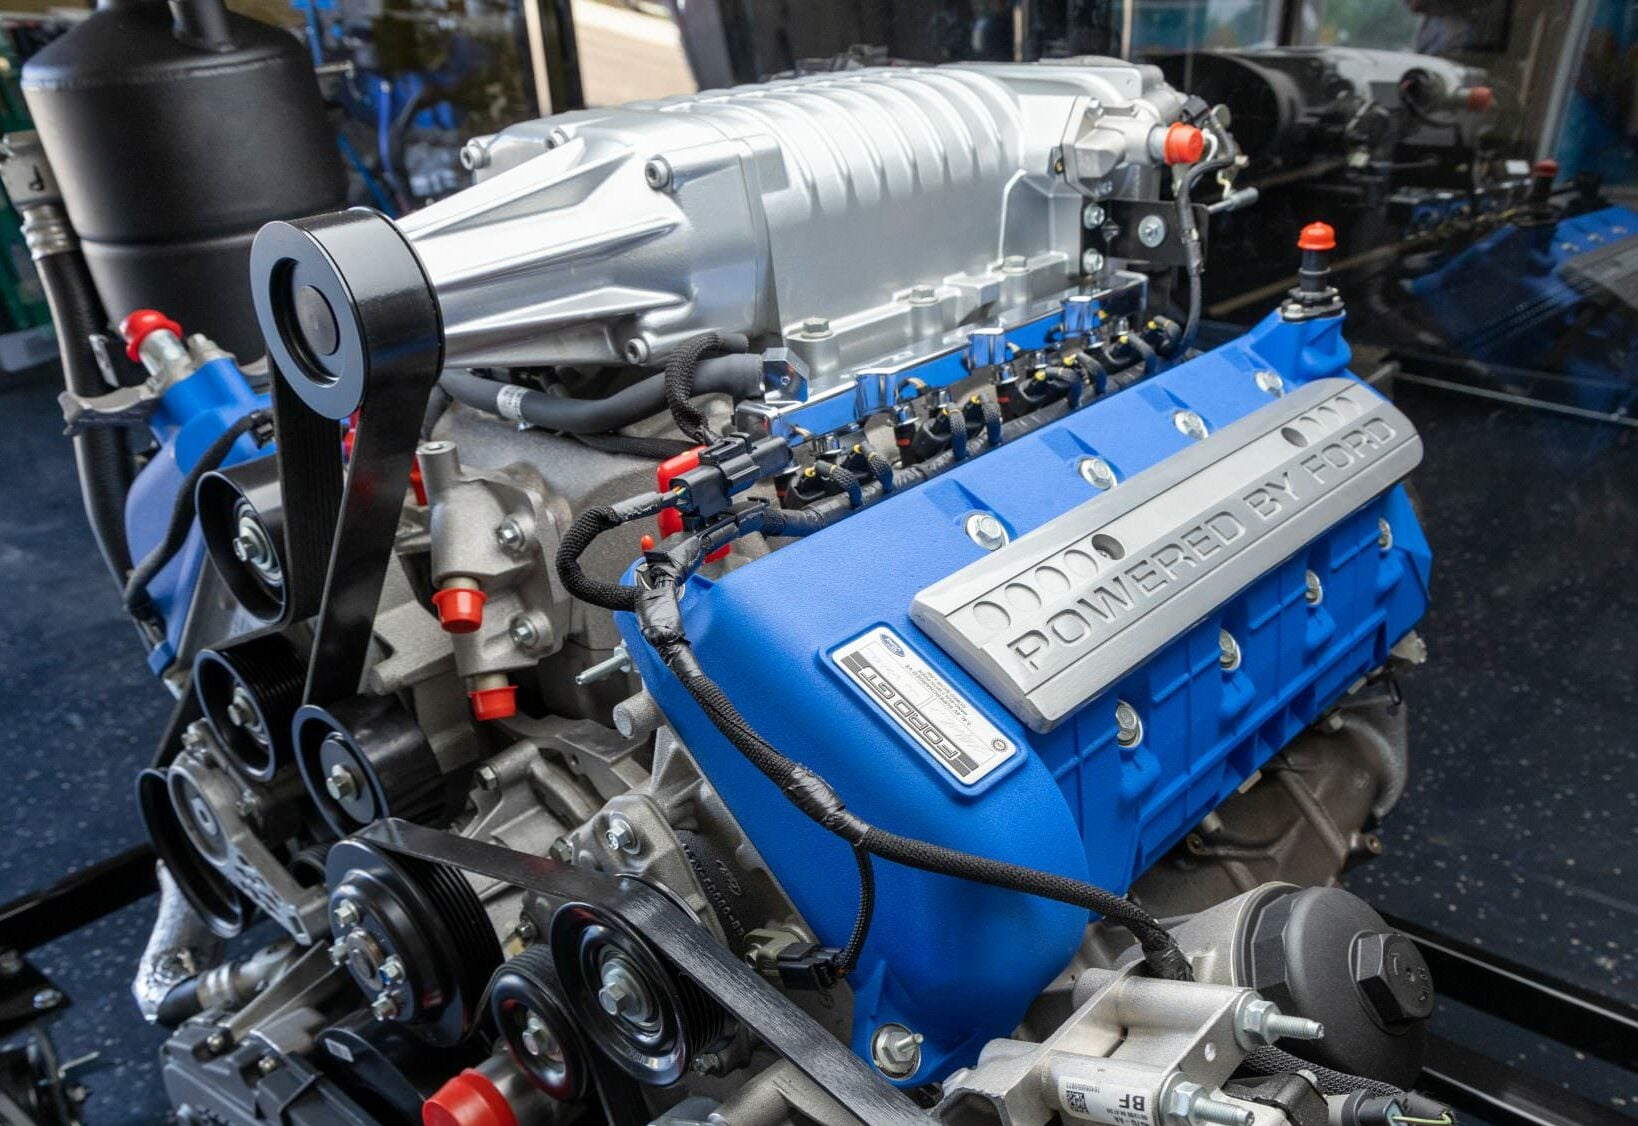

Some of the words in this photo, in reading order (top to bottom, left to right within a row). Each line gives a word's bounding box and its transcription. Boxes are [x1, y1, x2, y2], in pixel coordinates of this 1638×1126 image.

[1007, 510, 1247, 671] POWERED
[1242, 471, 1300, 521] BY
[1301, 417, 1396, 485] FORD
[859, 673, 895, 700] GT
[893, 699, 958, 759] FORD
[1119, 1093, 1145, 1112] BF
